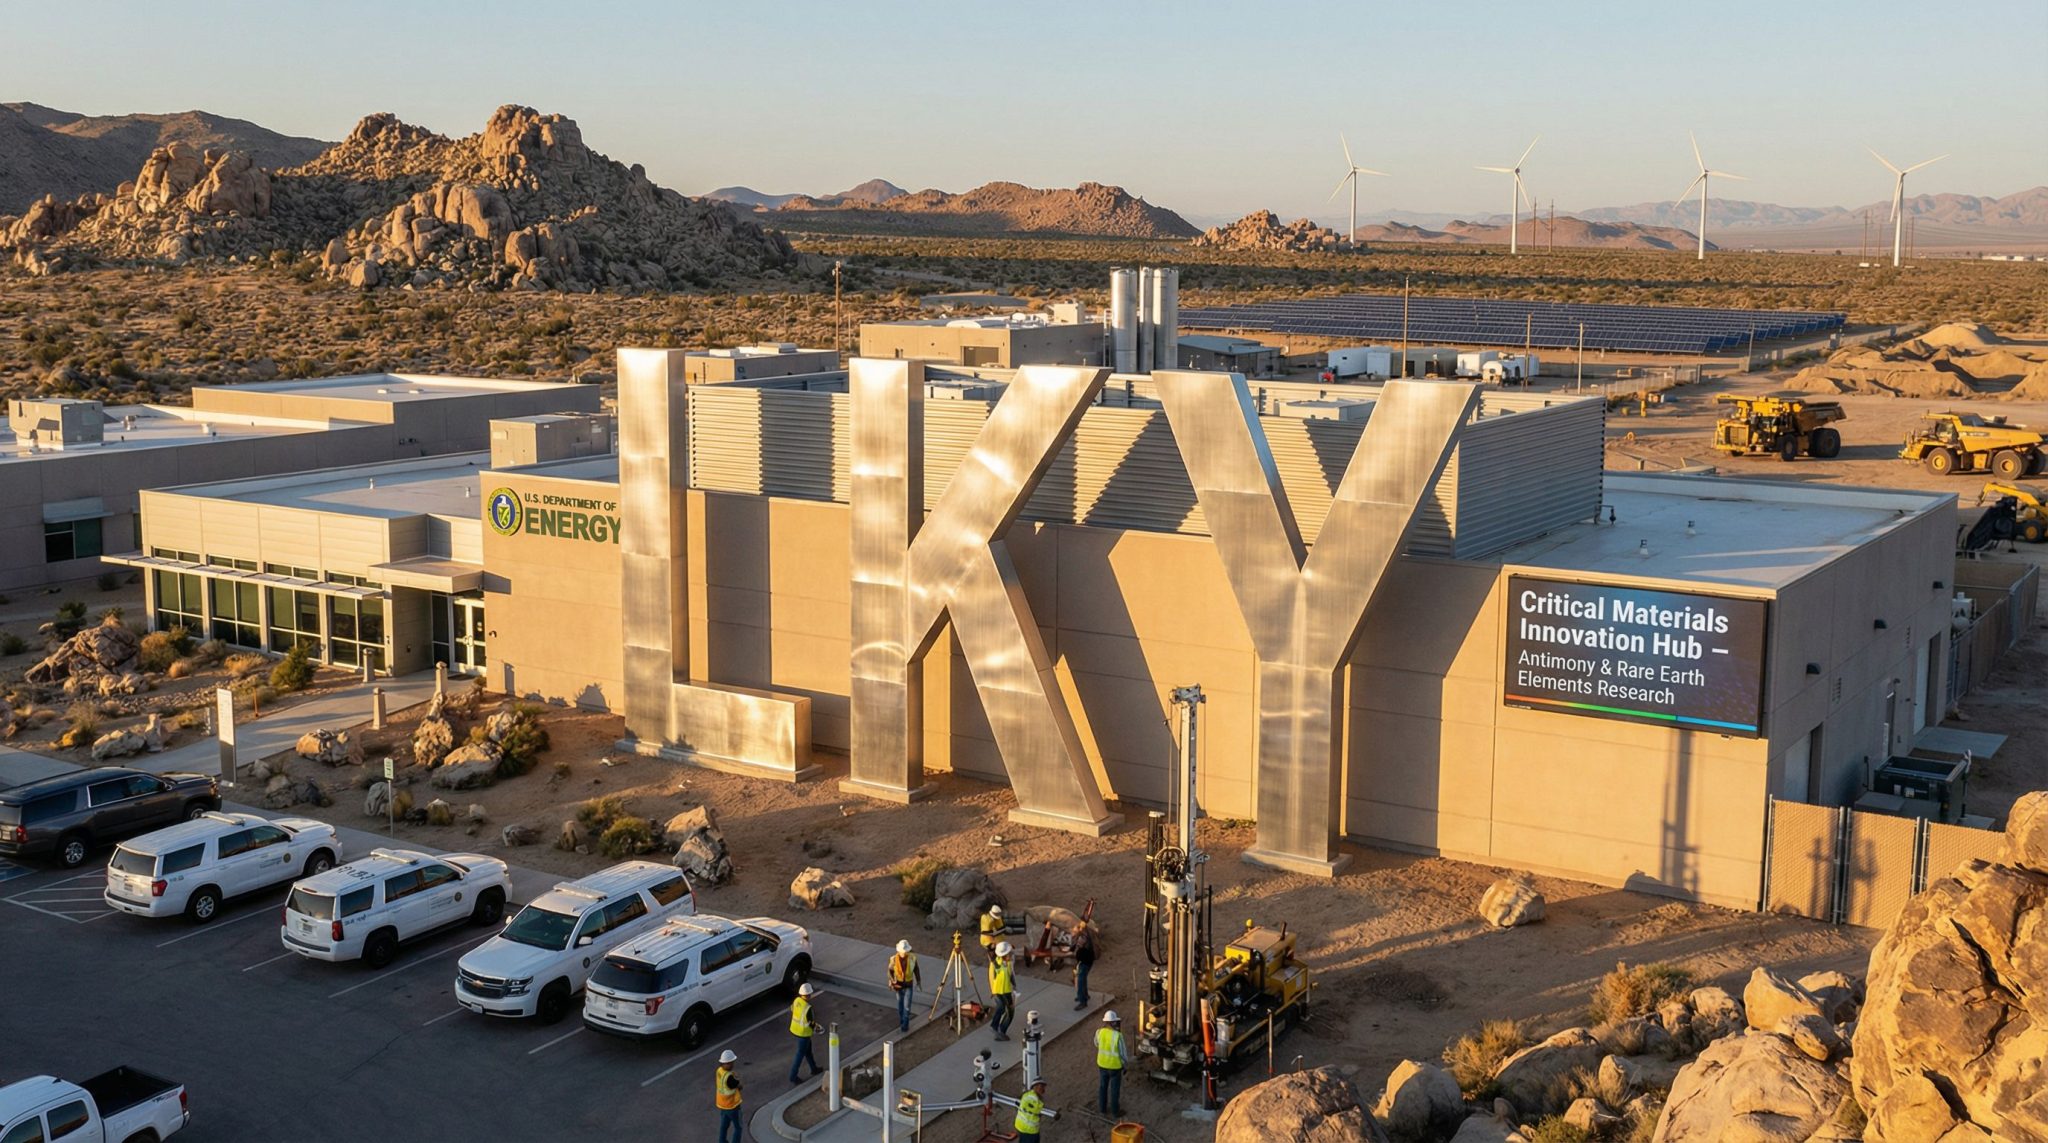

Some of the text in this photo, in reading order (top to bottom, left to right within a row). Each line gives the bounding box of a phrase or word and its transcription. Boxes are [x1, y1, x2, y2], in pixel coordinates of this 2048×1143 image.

[524, 493, 617, 512] U.S. DEPARTMENT OF
[525, 507, 621, 544] ENERGY
[617, 348, 1482, 864] LKY
[1520, 590, 1729, 634] Critical Materials
[1520, 618, 1644, 654] Innovation
[1653, 632, 1702, 660] Hub
[1518, 650, 1705, 687] Antimony & Rare Earth
[1518, 670, 1675, 705] Elements Research
